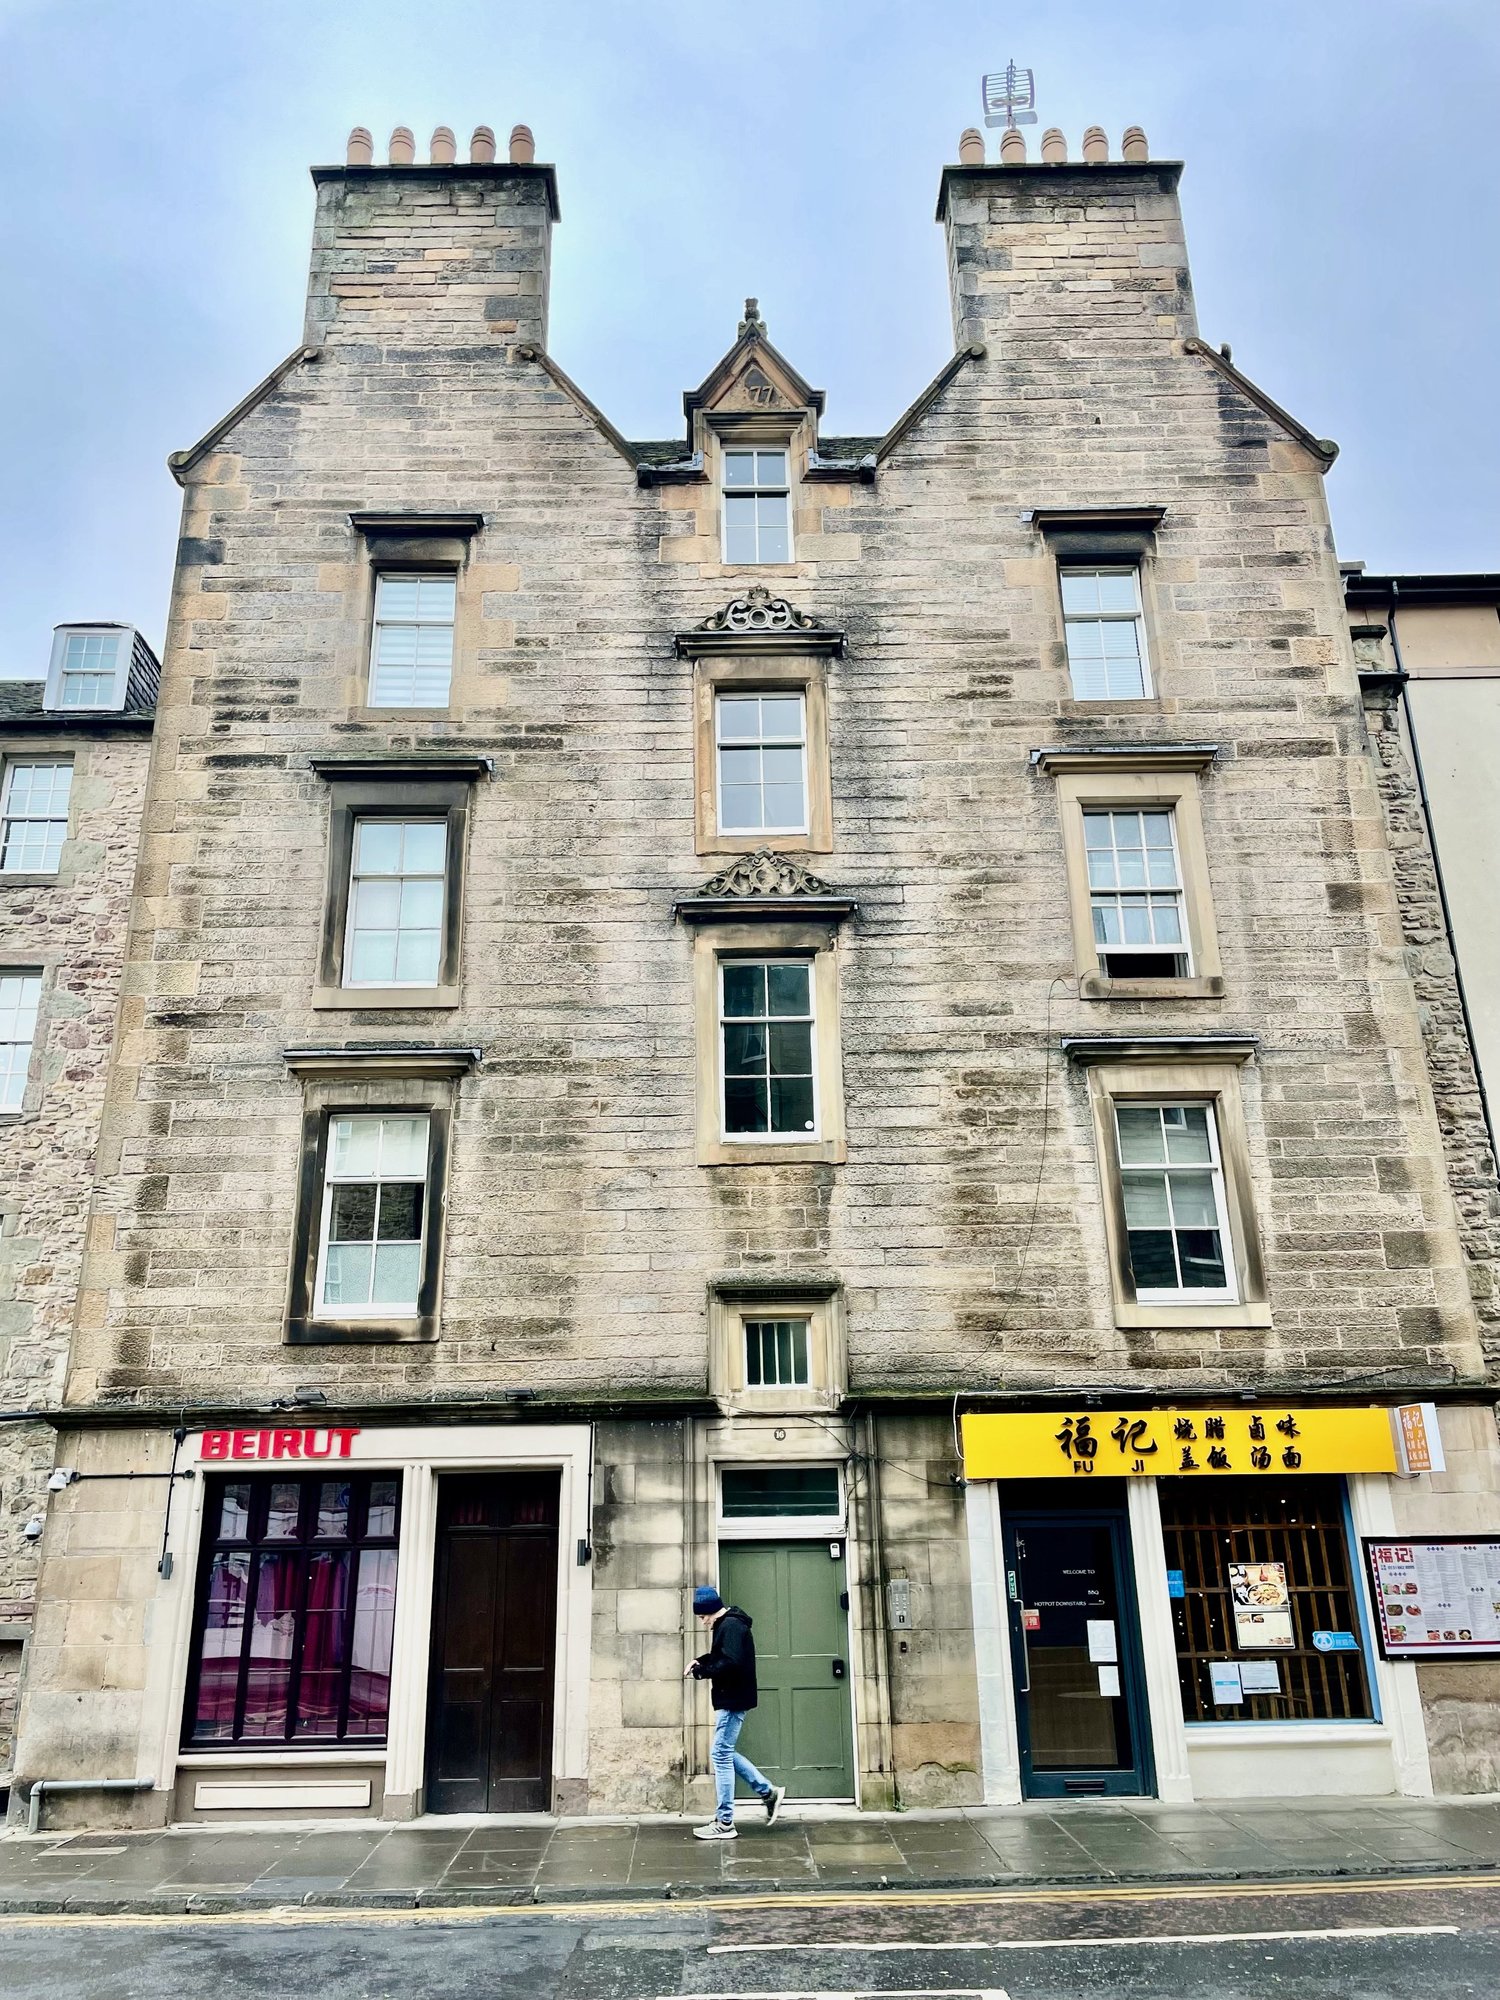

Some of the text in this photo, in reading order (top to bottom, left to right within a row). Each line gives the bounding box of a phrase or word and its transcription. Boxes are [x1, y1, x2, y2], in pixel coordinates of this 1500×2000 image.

[775, 1430, 785, 1439] 16
[1055, 1415, 1158, 1460] 福记
[200, 1427, 361, 1460] BEIRUT
[1073, 1459, 1145, 1473] FU JI
[1377, 1547, 1409, 1563] 福记
